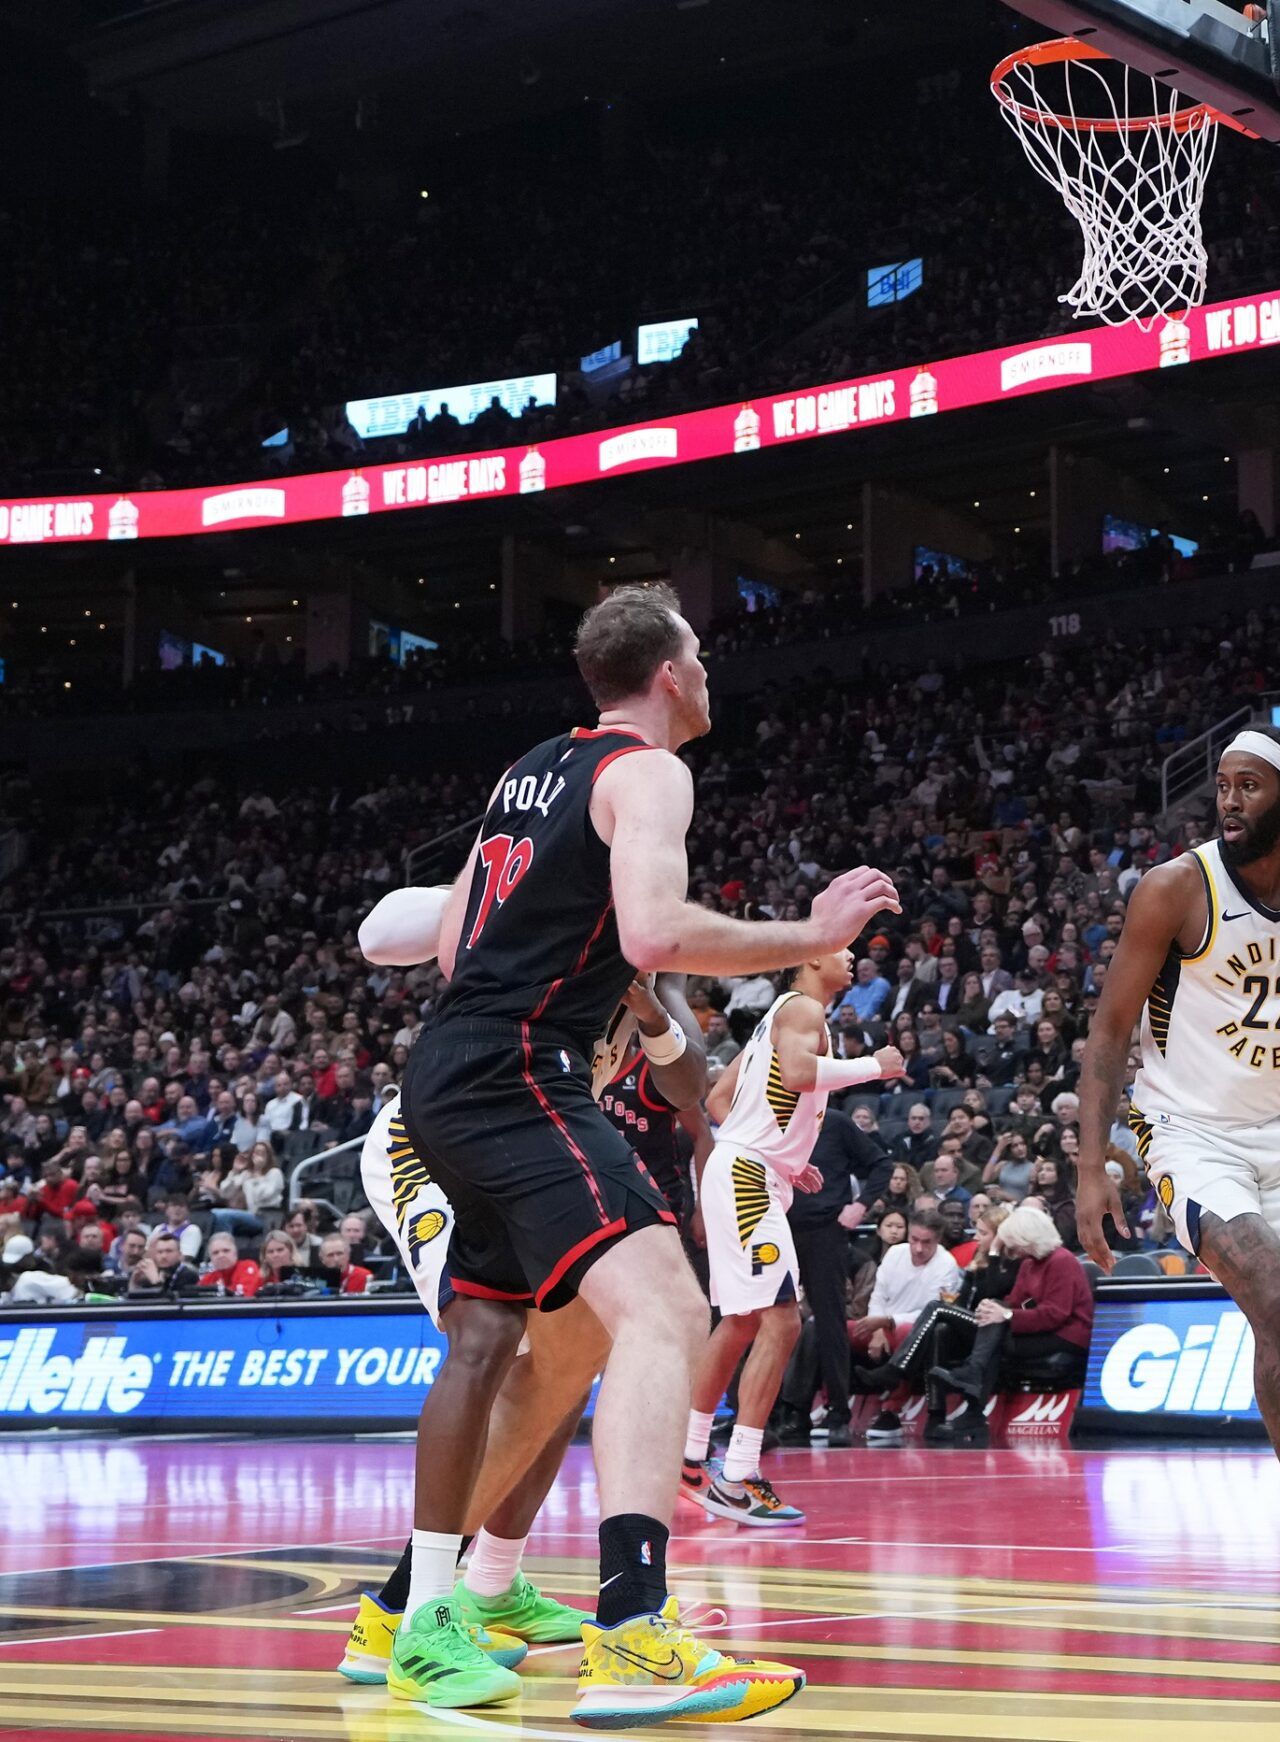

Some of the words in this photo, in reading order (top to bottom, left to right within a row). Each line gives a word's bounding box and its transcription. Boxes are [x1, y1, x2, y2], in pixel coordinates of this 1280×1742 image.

[1205, 308, 1233, 351] WE
[1233, 303, 1258, 347] DO
[1010, 351, 1082, 379] SMIRNOFF
[772, 399, 796, 439] WE
[796, 395, 817, 435] DO
[817, 385, 859, 431] GAME
[859, 379, 896, 421] DAYS
[383, 468, 407, 505] WE
[428, 459, 469, 501] GAME
[468, 456, 506, 494] DAYS
[0, 506, 9, 540] O
[9, 503, 54, 540] GAME
[54, 501, 94, 536] DAYS
[1048, 613, 1081, 637] 118
[600, 1095, 649, 1132] TORS
[0, 1328, 153, 1413] llette
[169, 1350, 235, 1387] THE
[238, 1348, 328, 1387] BEST
[335, 1347, 442, 1386] YOUR
[1007, 1425, 1060, 1435] MAGELLAN
